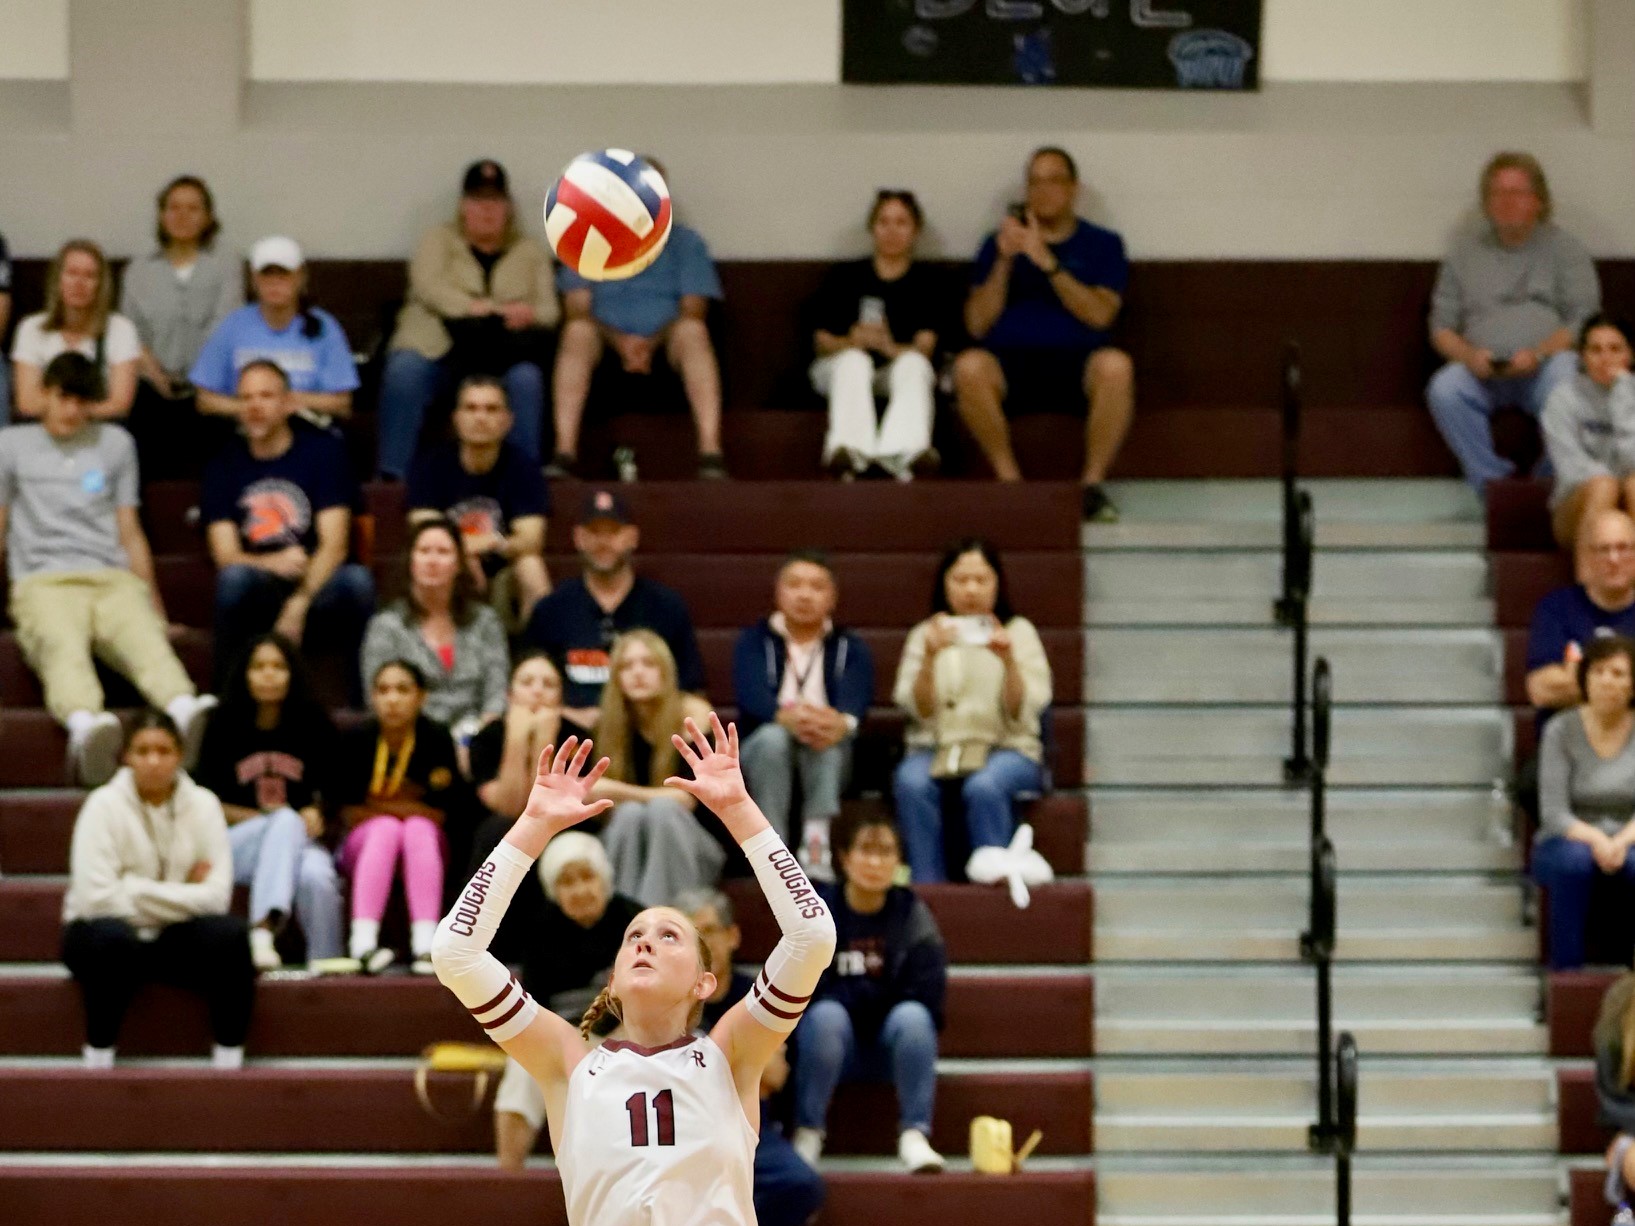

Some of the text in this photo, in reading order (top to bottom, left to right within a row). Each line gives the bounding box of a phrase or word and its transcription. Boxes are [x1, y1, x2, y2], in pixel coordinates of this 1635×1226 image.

[449, 861, 496, 937] COUGARS
[768, 848, 825, 919] COUGARS
[625, 1088, 675, 1147] 11
